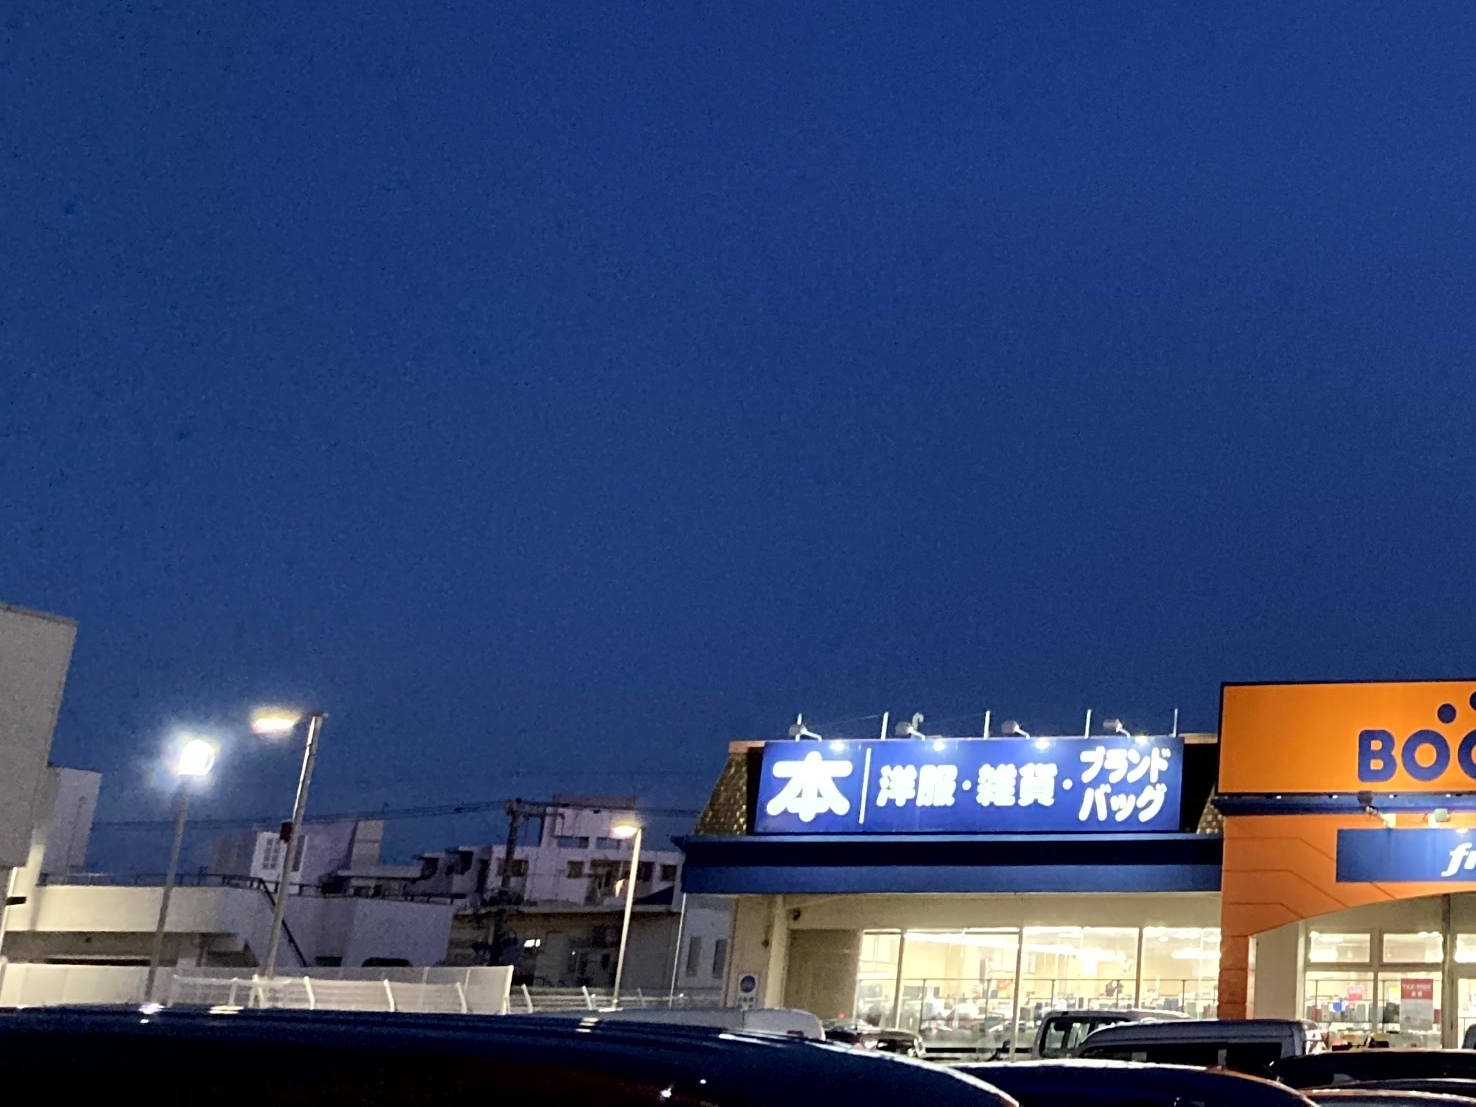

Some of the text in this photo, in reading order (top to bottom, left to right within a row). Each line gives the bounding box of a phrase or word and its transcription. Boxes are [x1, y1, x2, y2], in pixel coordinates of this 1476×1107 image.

[1079, 745, 1172, 784] ブランド
[766, 750, 853, 823] 本
[1078, 783, 1168, 823] バッグ
